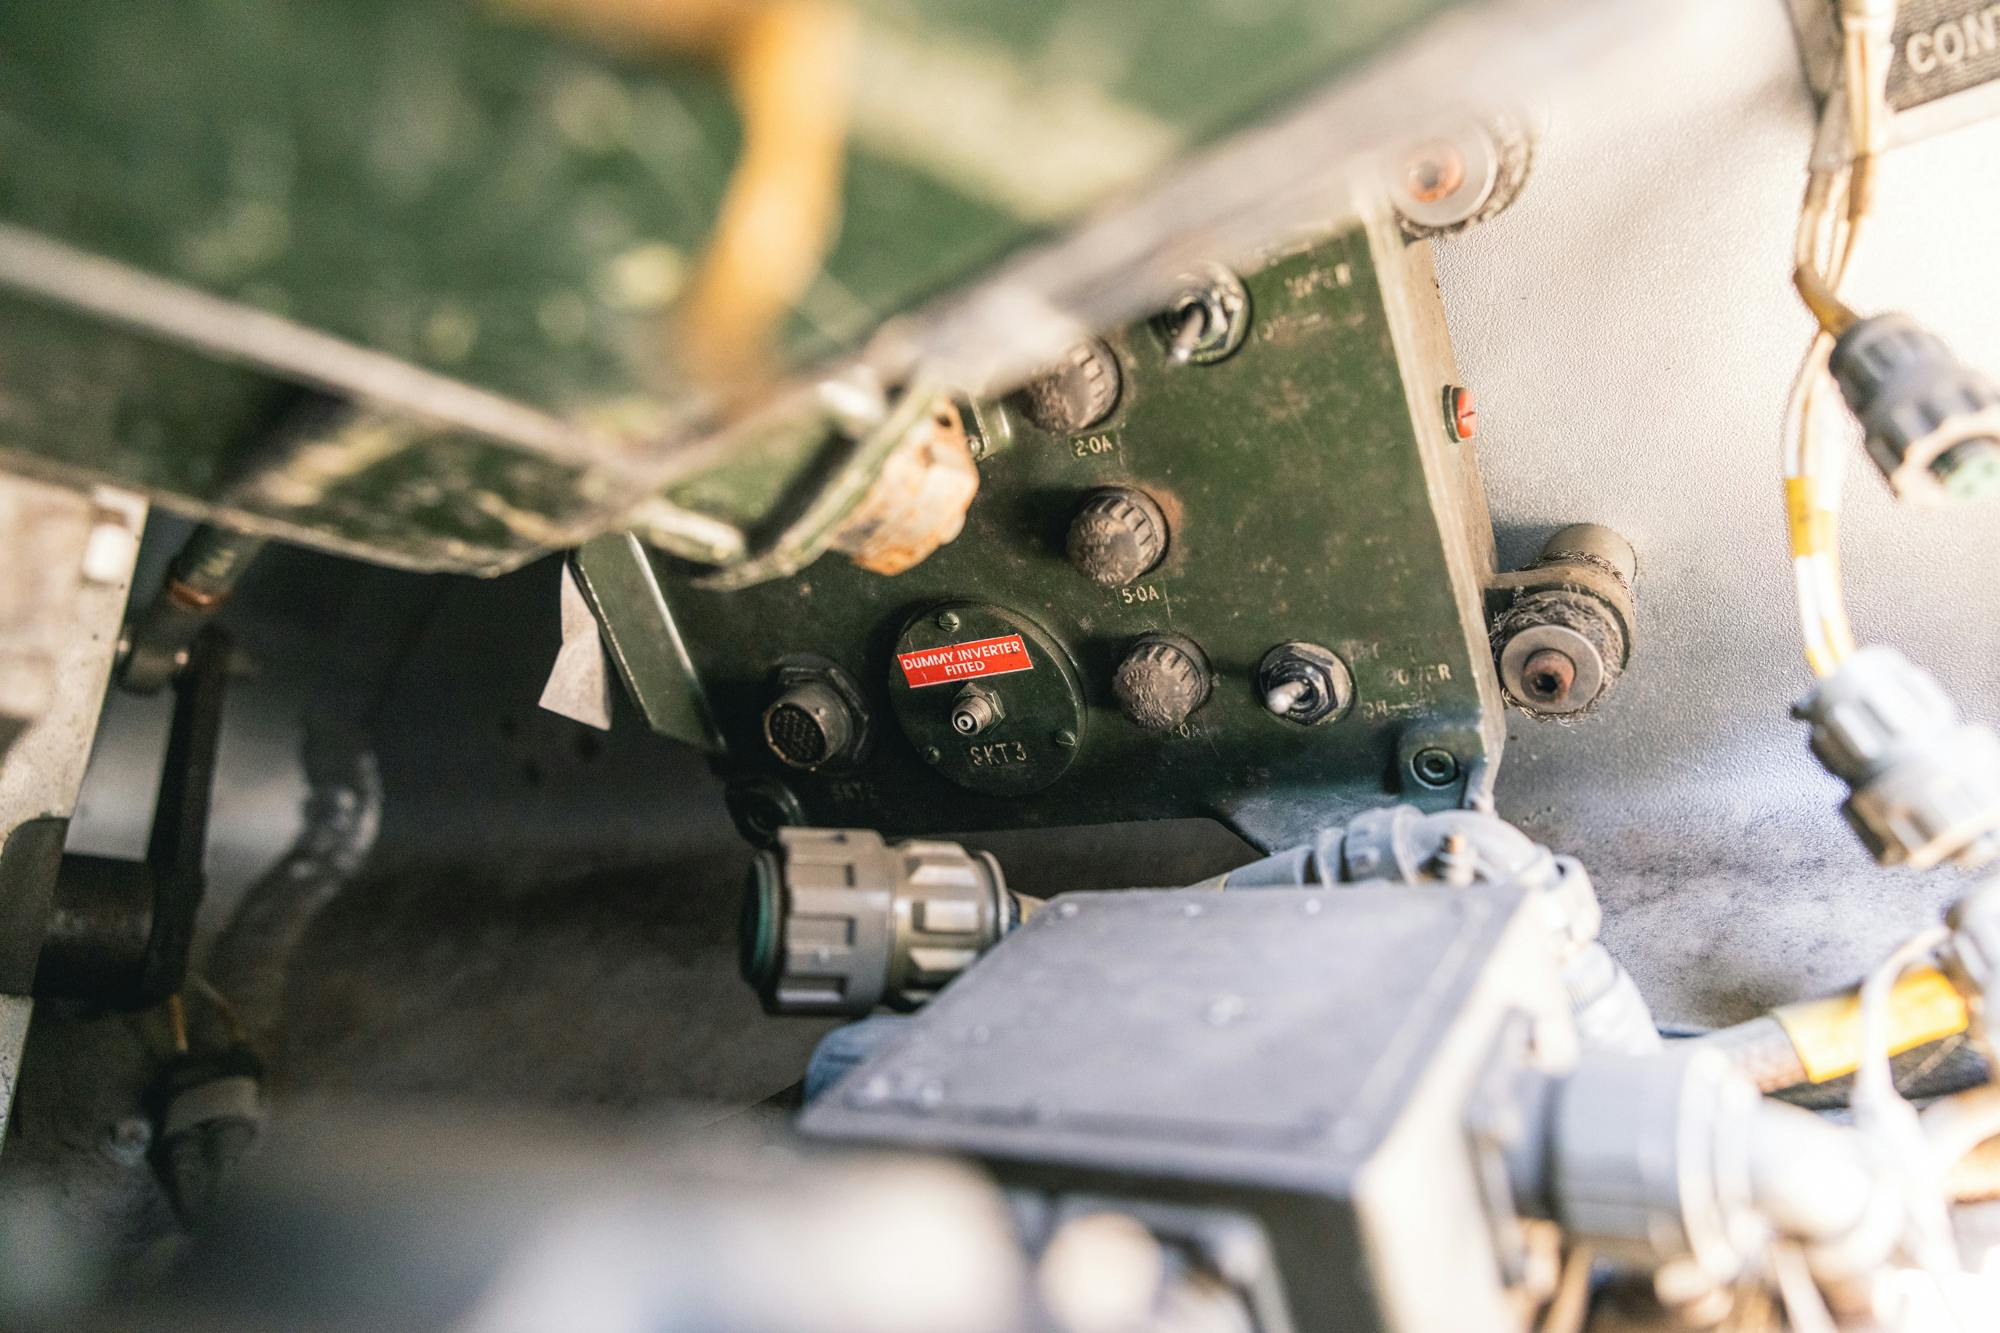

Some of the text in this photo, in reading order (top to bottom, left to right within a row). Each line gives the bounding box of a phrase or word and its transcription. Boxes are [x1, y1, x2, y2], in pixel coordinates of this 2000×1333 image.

[1905, 4, 2000, 74] CON
[902, 641, 1021, 671] DUMMY INVERTER
[944, 661, 986, 676] FITTED
[970, 741, 1027, 766] SKT 3
